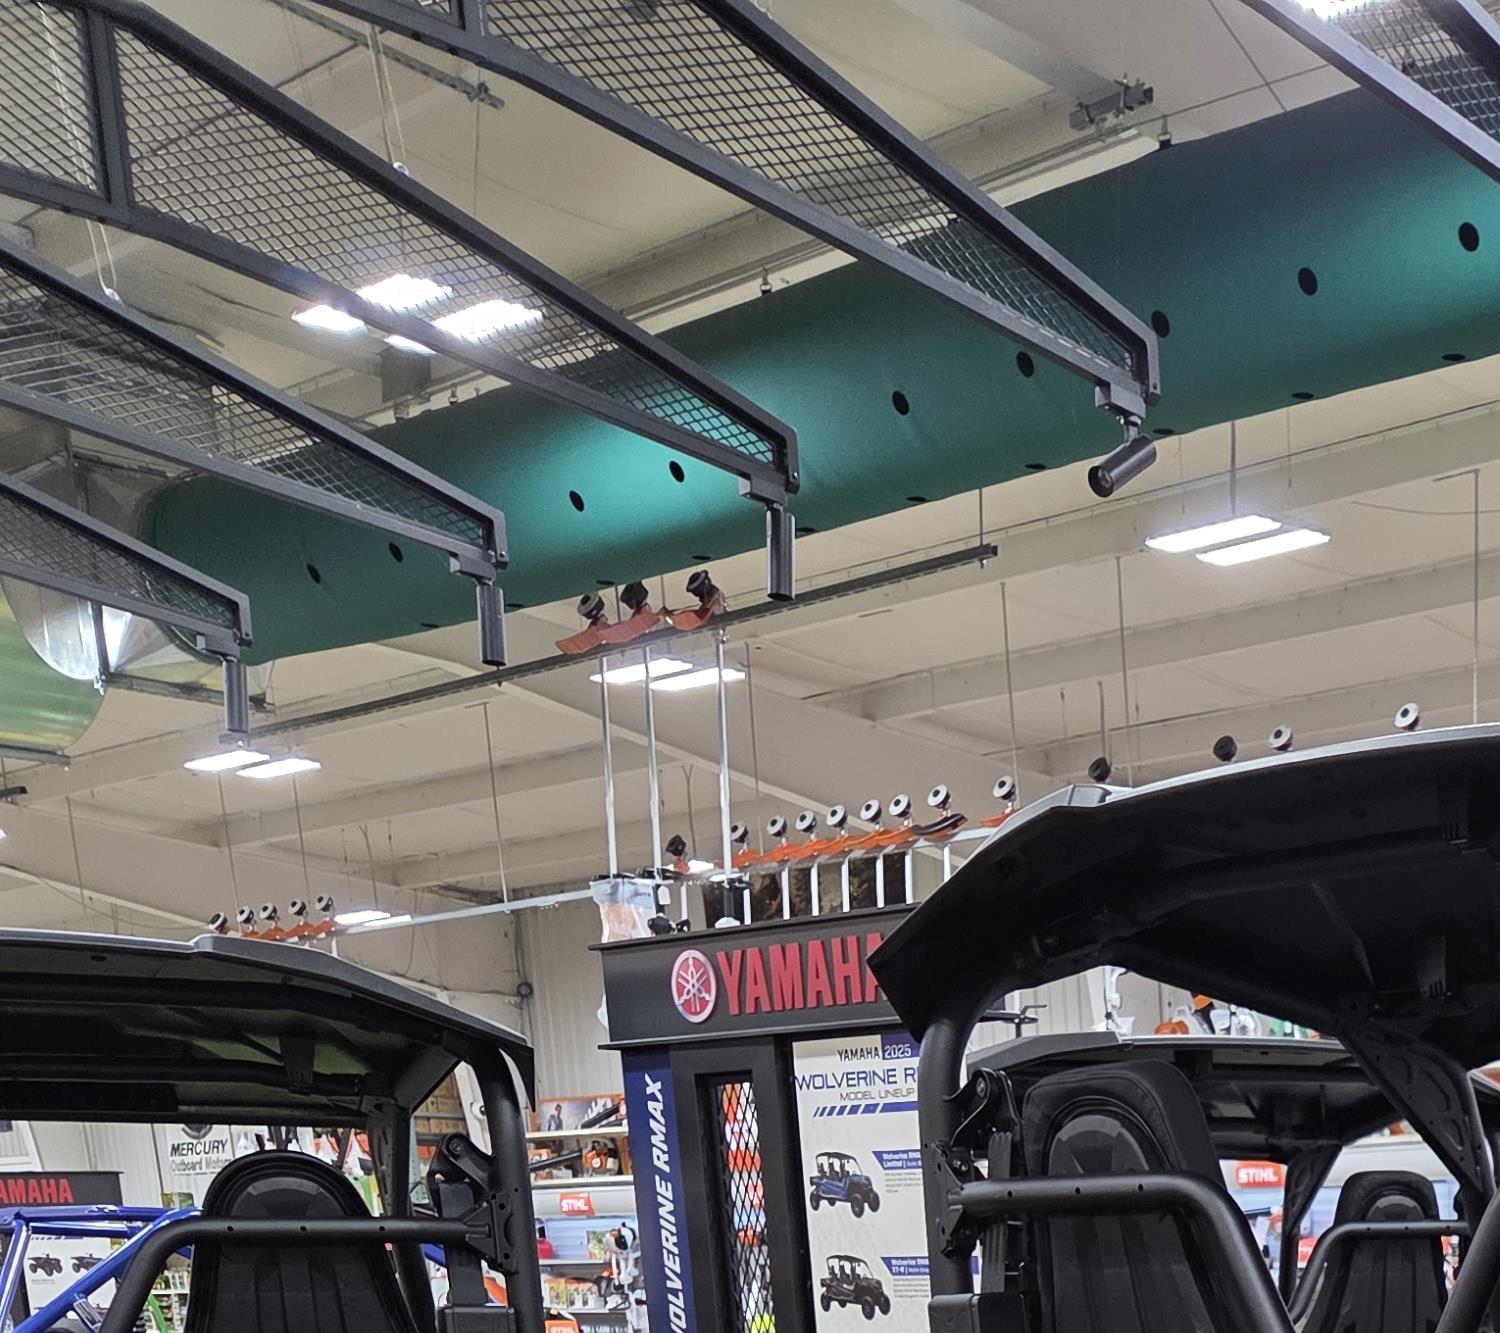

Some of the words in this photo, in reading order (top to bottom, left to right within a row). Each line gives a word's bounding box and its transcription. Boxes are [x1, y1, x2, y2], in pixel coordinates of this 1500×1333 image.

[838, 1046, 881, 1062] YAMAHA
[884, 1044, 912, 1059] 2025
[793, 1068, 898, 1091] WOLVERINE
[840, 1091, 876, 1101] MODEL
[879, 1087, 916, 1099] LINEUP
[644, 1073, 671, 1174] RMAX
[170, 1139, 228, 1157] MERCURY
[1238, 1167, 1279, 1183] STIHL
[561, 1198, 589, 1212] STIHL
